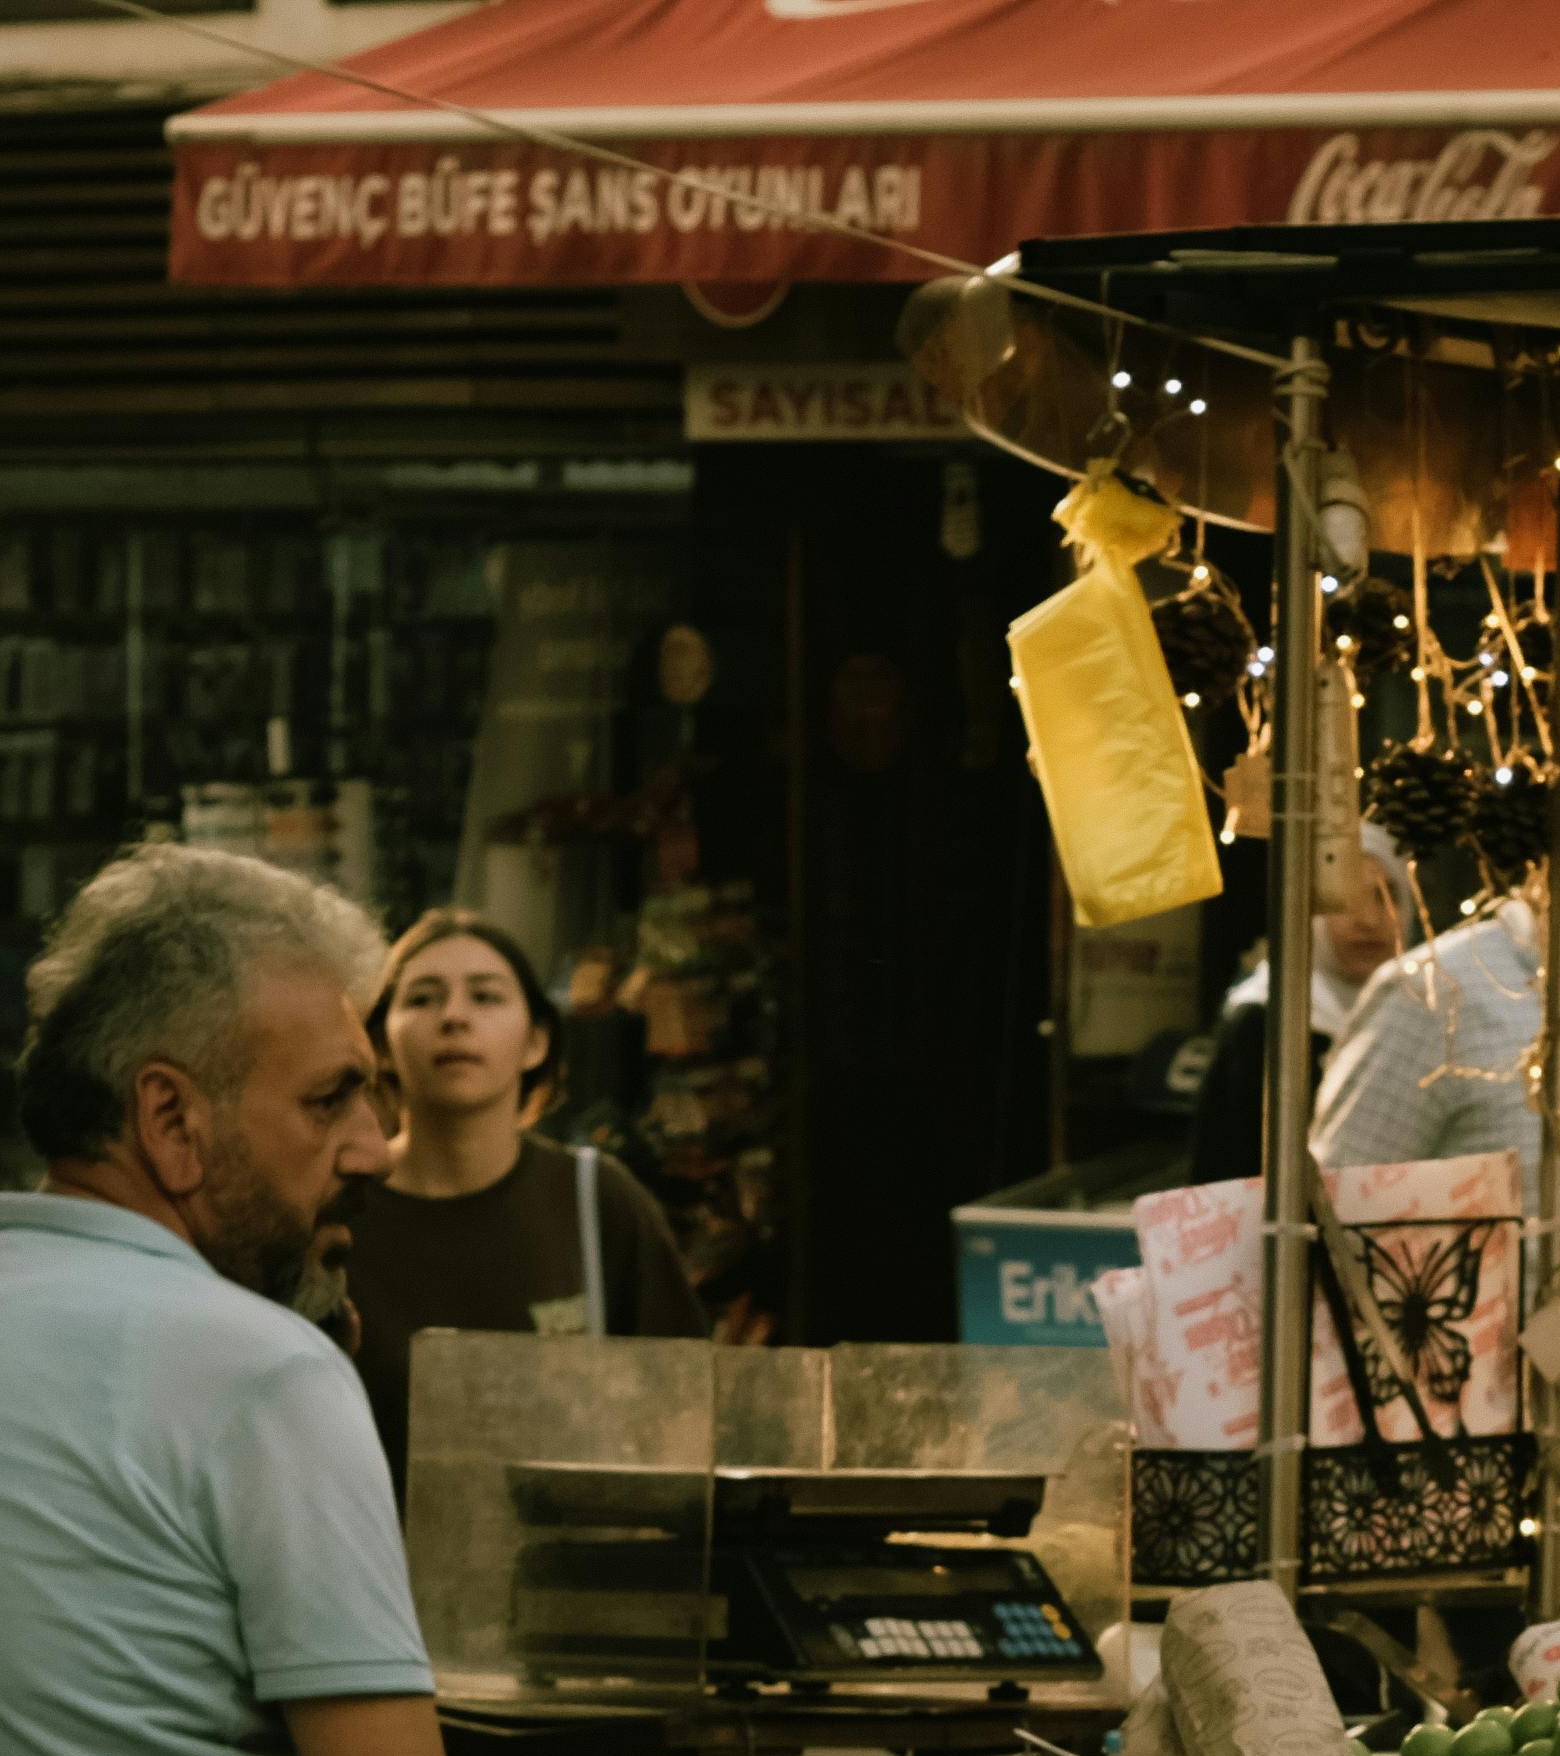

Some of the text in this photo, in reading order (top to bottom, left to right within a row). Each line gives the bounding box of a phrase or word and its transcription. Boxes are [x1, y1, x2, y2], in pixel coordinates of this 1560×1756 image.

[196, 155, 922, 250] GÜVENÇ BÜFE ŞANS OYUNLARI
[711, 380, 953, 428] SAYISAL
